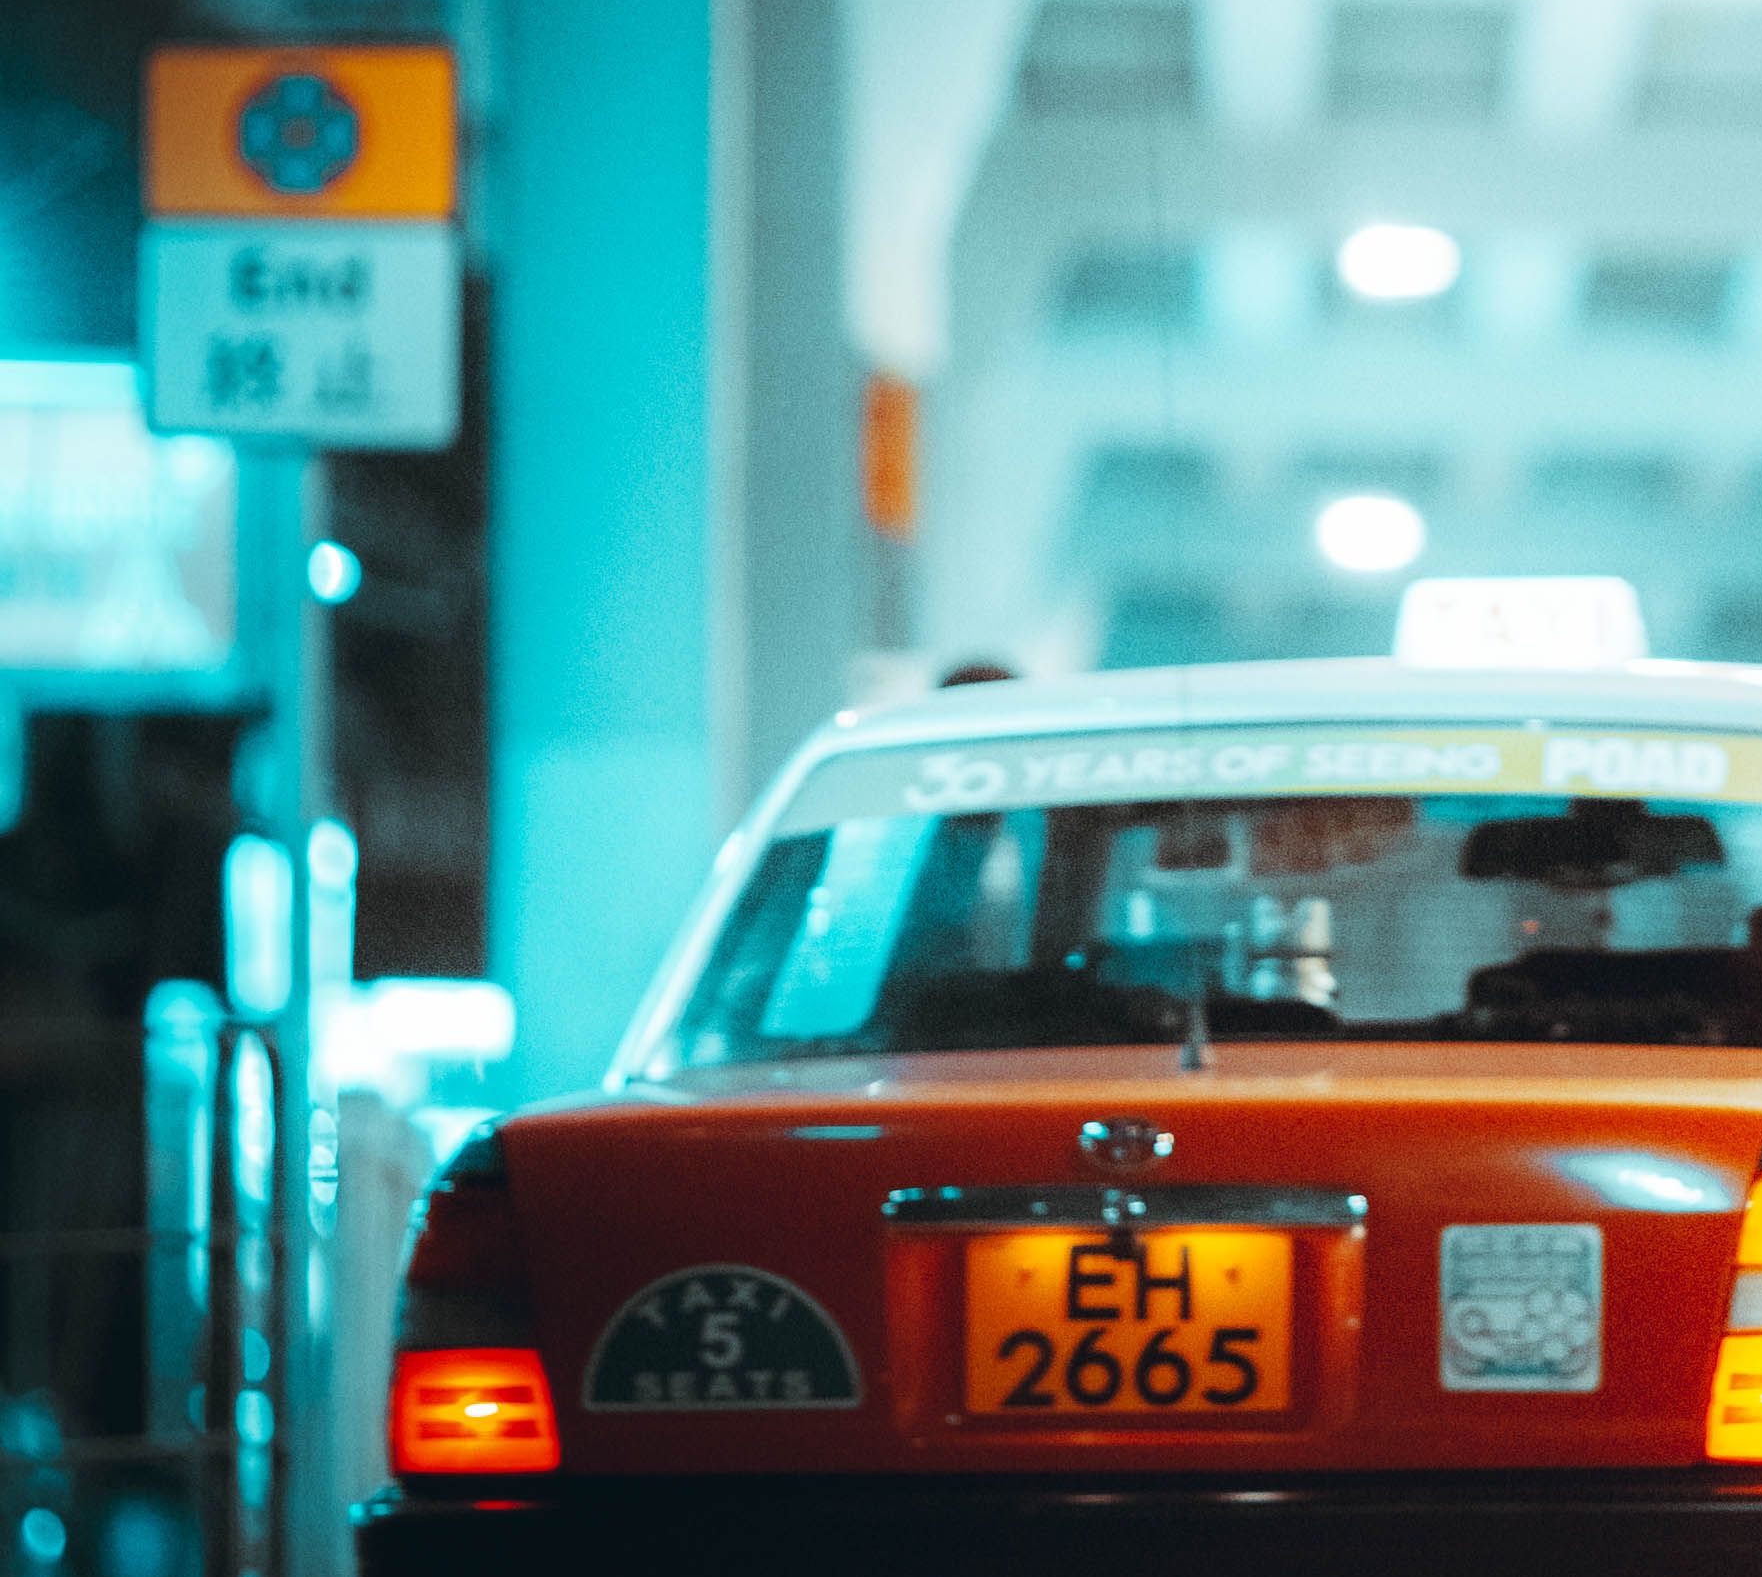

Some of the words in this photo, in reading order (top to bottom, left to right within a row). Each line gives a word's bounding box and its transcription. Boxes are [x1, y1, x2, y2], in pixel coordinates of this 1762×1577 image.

[1022, 748, 1202, 791] YEARS
[1211, 743, 1294, 781] OF
[1302, 742, 1502, 782] SEEING
[637, 1279, 793, 1327] TAXI
[1067, 1244, 1192, 1320] EH
[701, 1313, 743, 1368] 5
[998, 1327, 1259, 1406] 2665
[634, 1369, 813, 1402] SEATS
